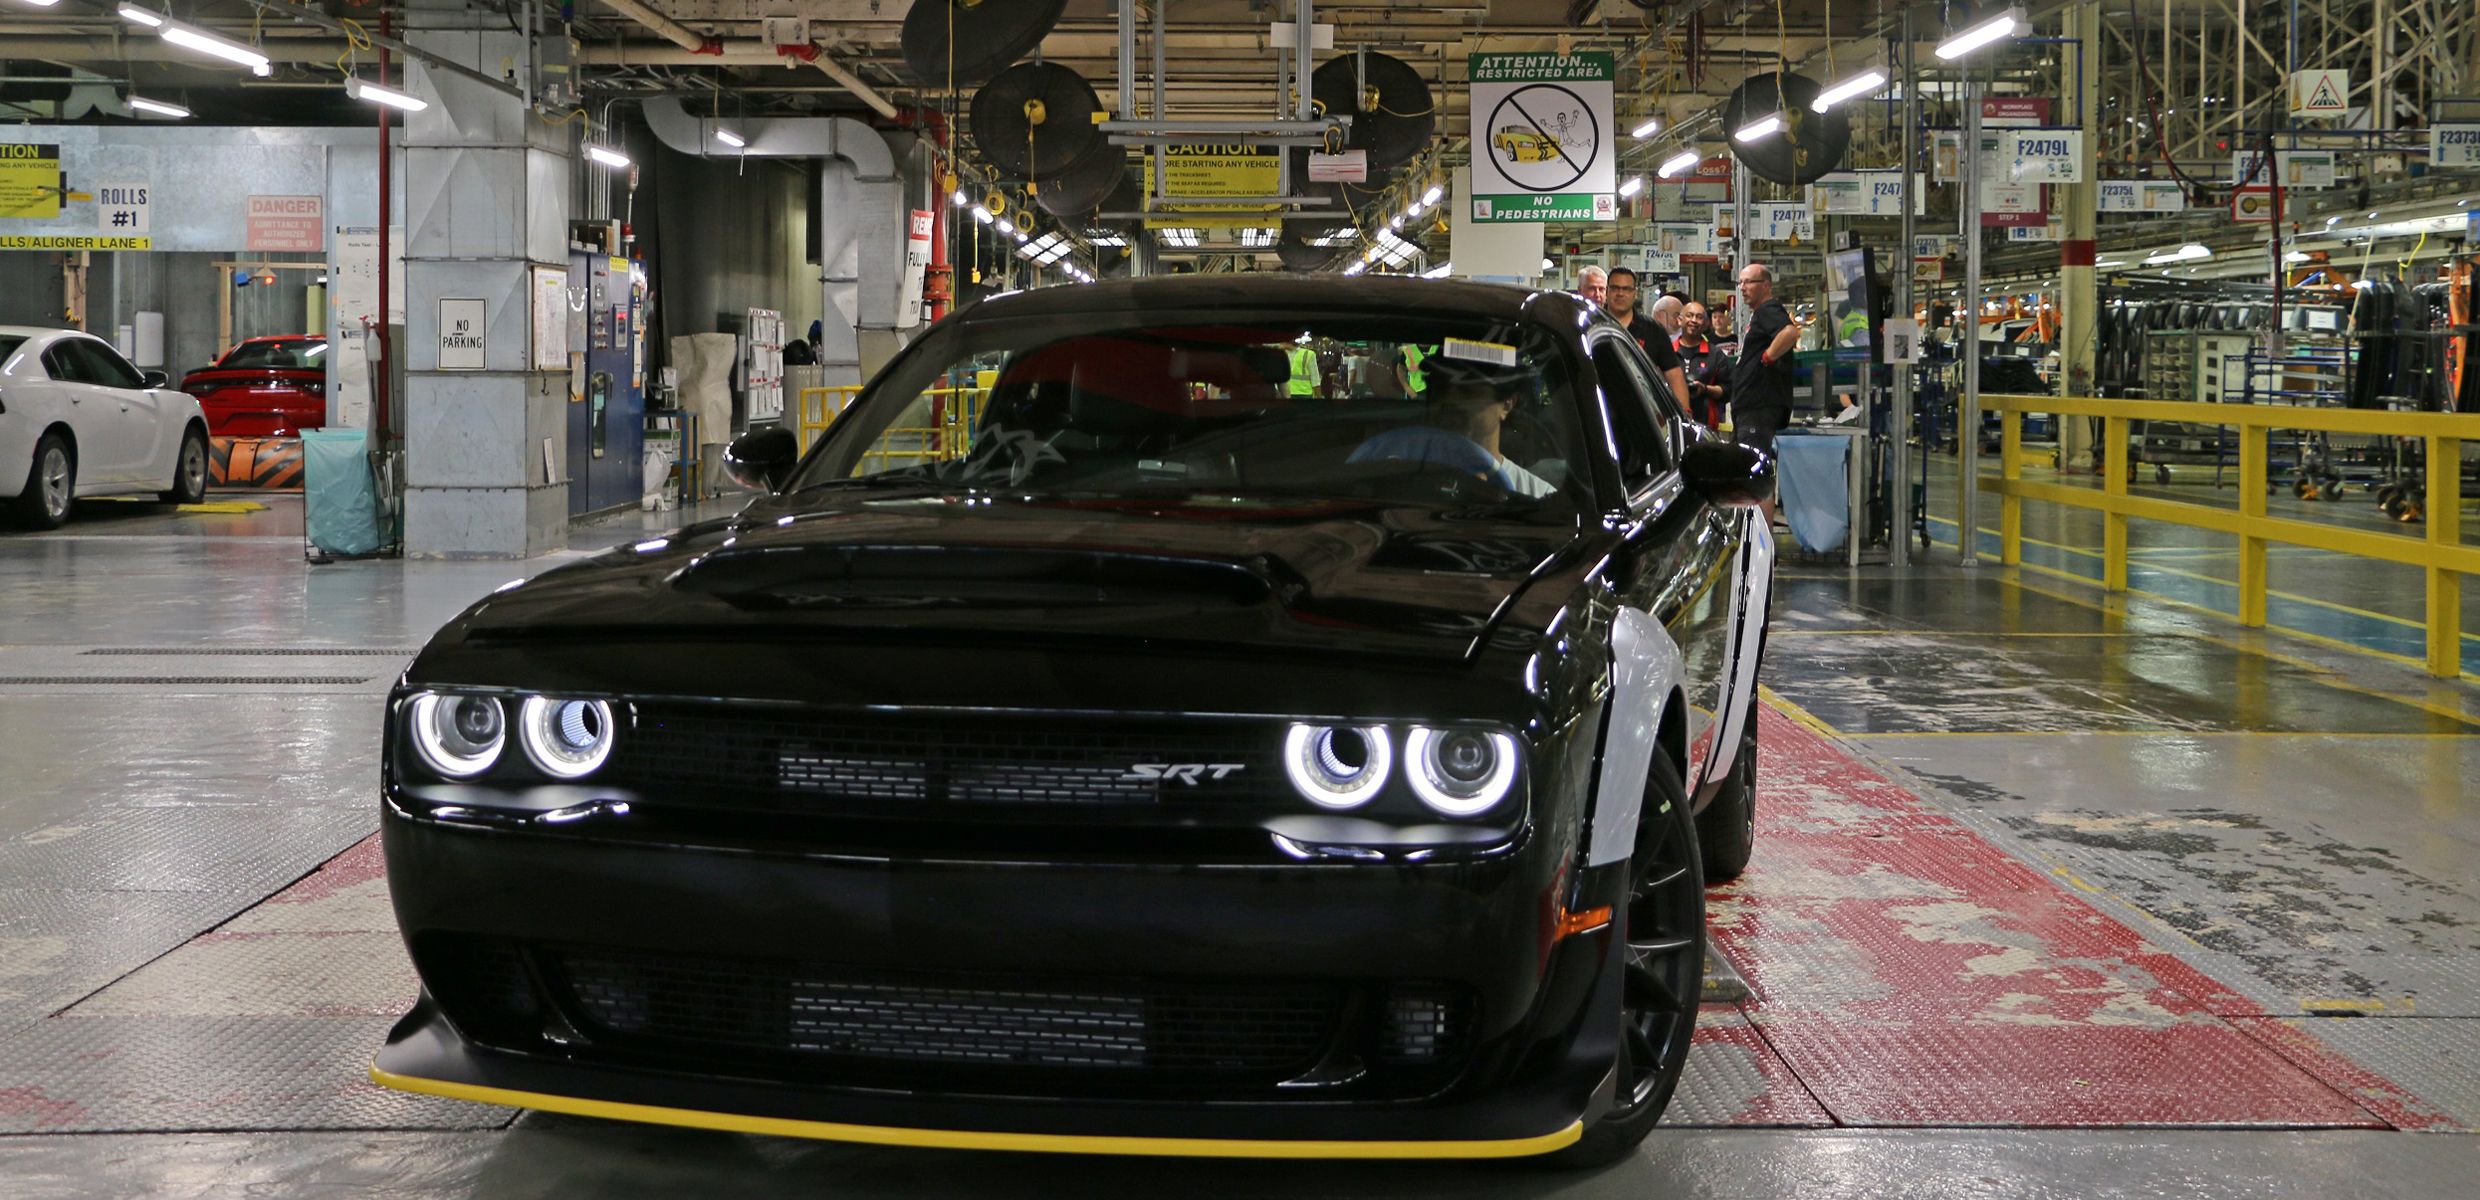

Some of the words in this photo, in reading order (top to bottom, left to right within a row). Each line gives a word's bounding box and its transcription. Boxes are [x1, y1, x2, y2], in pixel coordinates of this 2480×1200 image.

[1480, 56, 1597, 68] ATTENTION...
[1476, 68, 1562, 78] RESTRICTED
[1567, 68, 1602, 77] AREA
[2440, 130, 2480, 144] F2373
[2018, 140, 2069, 156] F2479L
[1182, 160, 1223, 168] STARTING
[1225, 160, 1241, 168] ANY
[1244, 160, 1279, 168] VEHICLE
[101, 188, 147, 204] ROLLS
[2102, 185, 2133, 196] F2375L
[252, 200, 317, 213] DANGER
[1534, 196, 1553, 206] NO
[112, 211, 137, 226] #1
[1496, 209, 1591, 219] PEDESTRIANS
[100, 237, 136, 248] LANE
[143, 238, 149, 248] 1
[456, 319, 469, 331] NO
[442, 336, 483, 349] PARKING
[1121, 764, 1246, 785] SRT
